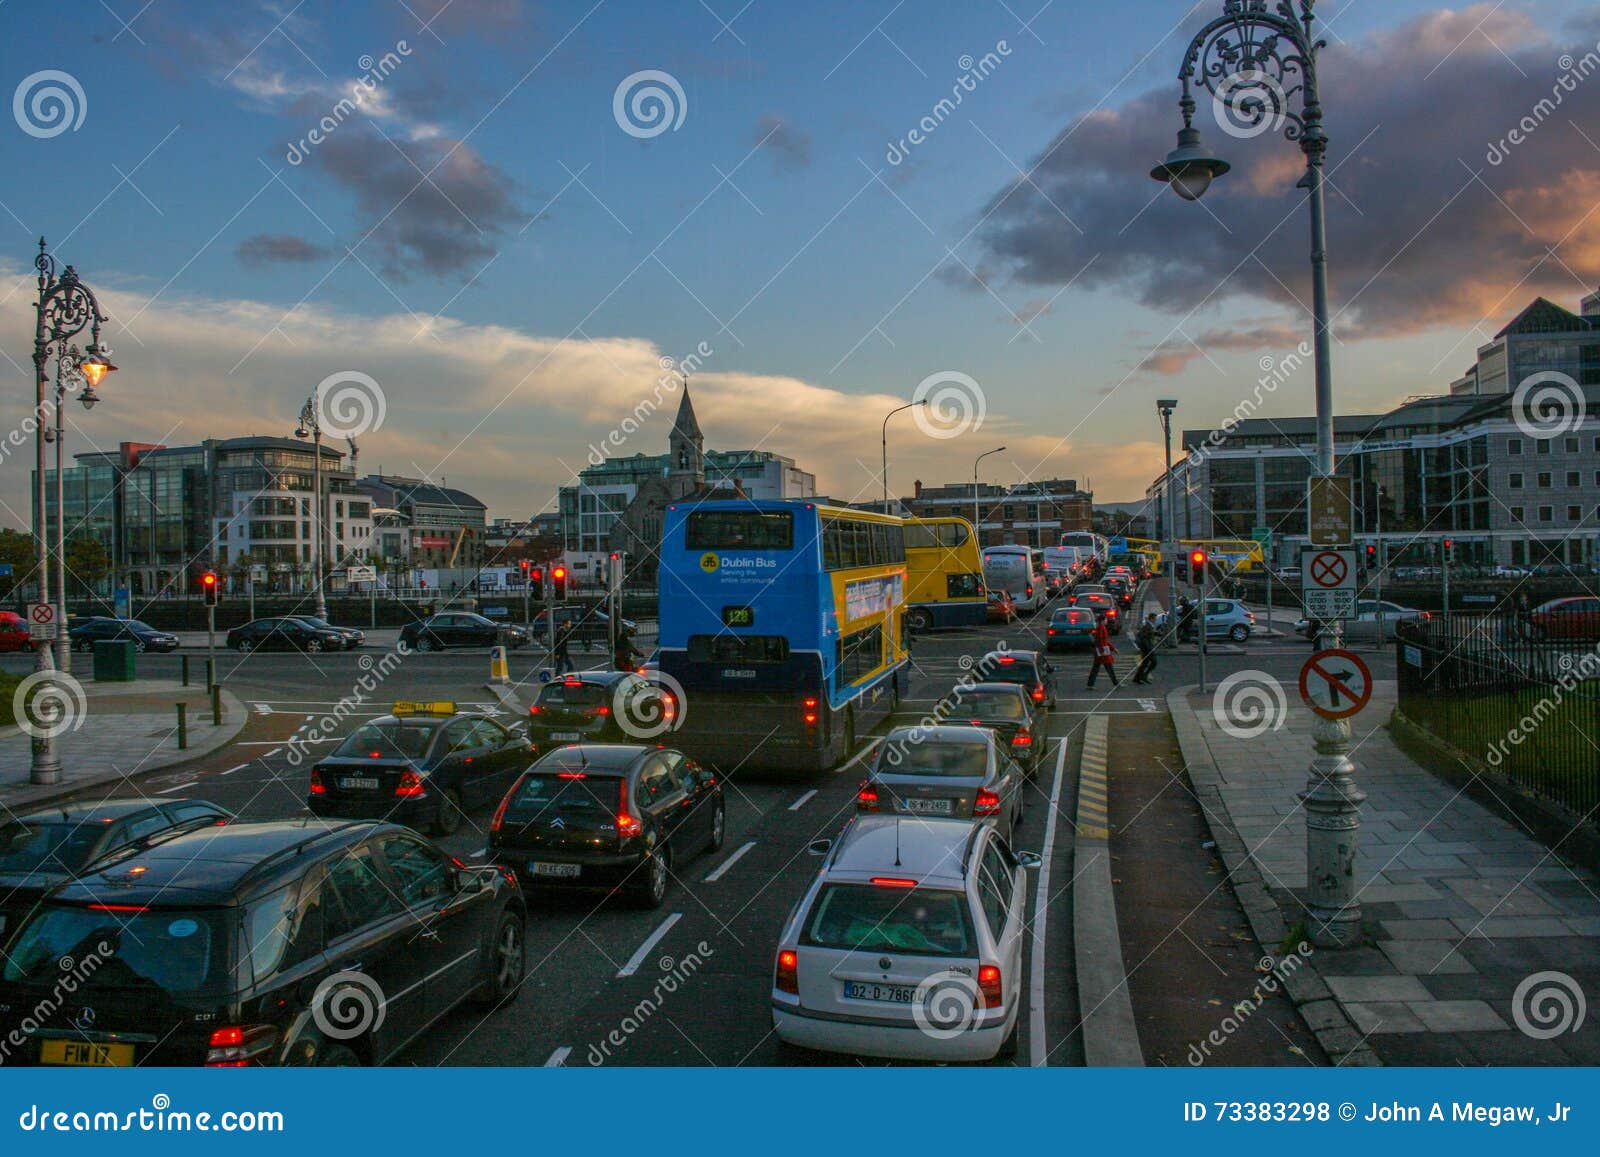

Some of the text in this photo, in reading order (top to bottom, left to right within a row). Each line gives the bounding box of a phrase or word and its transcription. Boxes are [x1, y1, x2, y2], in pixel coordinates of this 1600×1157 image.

[721, 557, 777, 568] Dublin Bus
[721, 569, 745, 577] Serving
